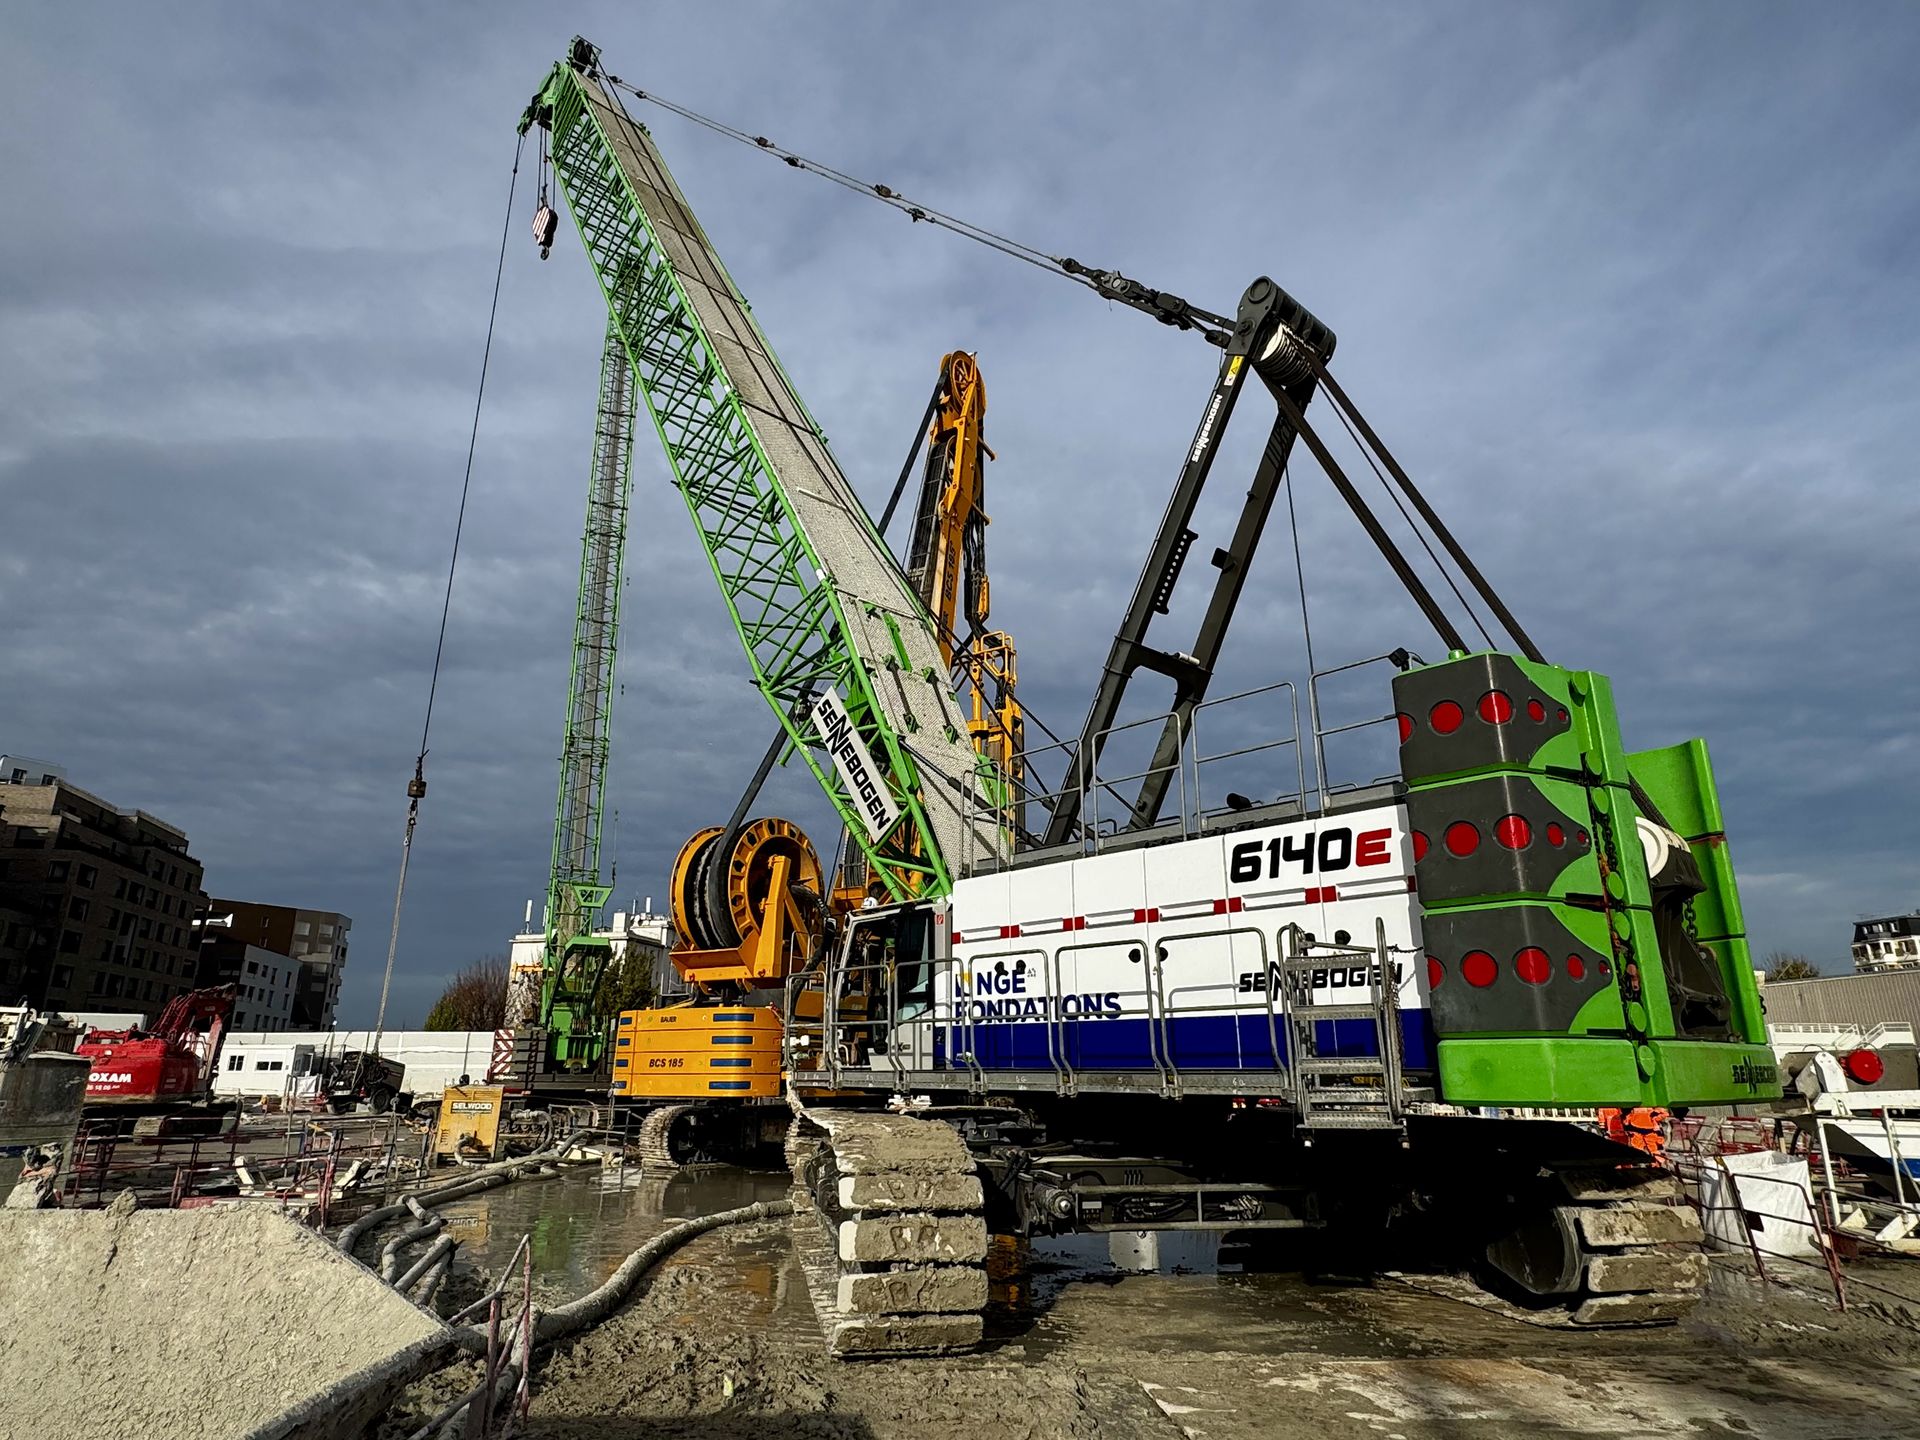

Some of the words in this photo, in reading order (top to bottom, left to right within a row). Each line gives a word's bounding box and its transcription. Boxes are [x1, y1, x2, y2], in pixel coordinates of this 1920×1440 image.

[1191, 394, 1223, 463] SENNEBOGEN
[817, 699, 892, 831] SENNEBOGEN
[1230, 826, 1393, 884] 6140E
[955, 992, 1123, 1025] FONDATIONS
[88, 1073, 132, 1083] OXAM
[648, 1058, 667, 1068] BCS
[668, 1058, 684, 1068] 185
[452, 1102, 493, 1110] SELWOOD
